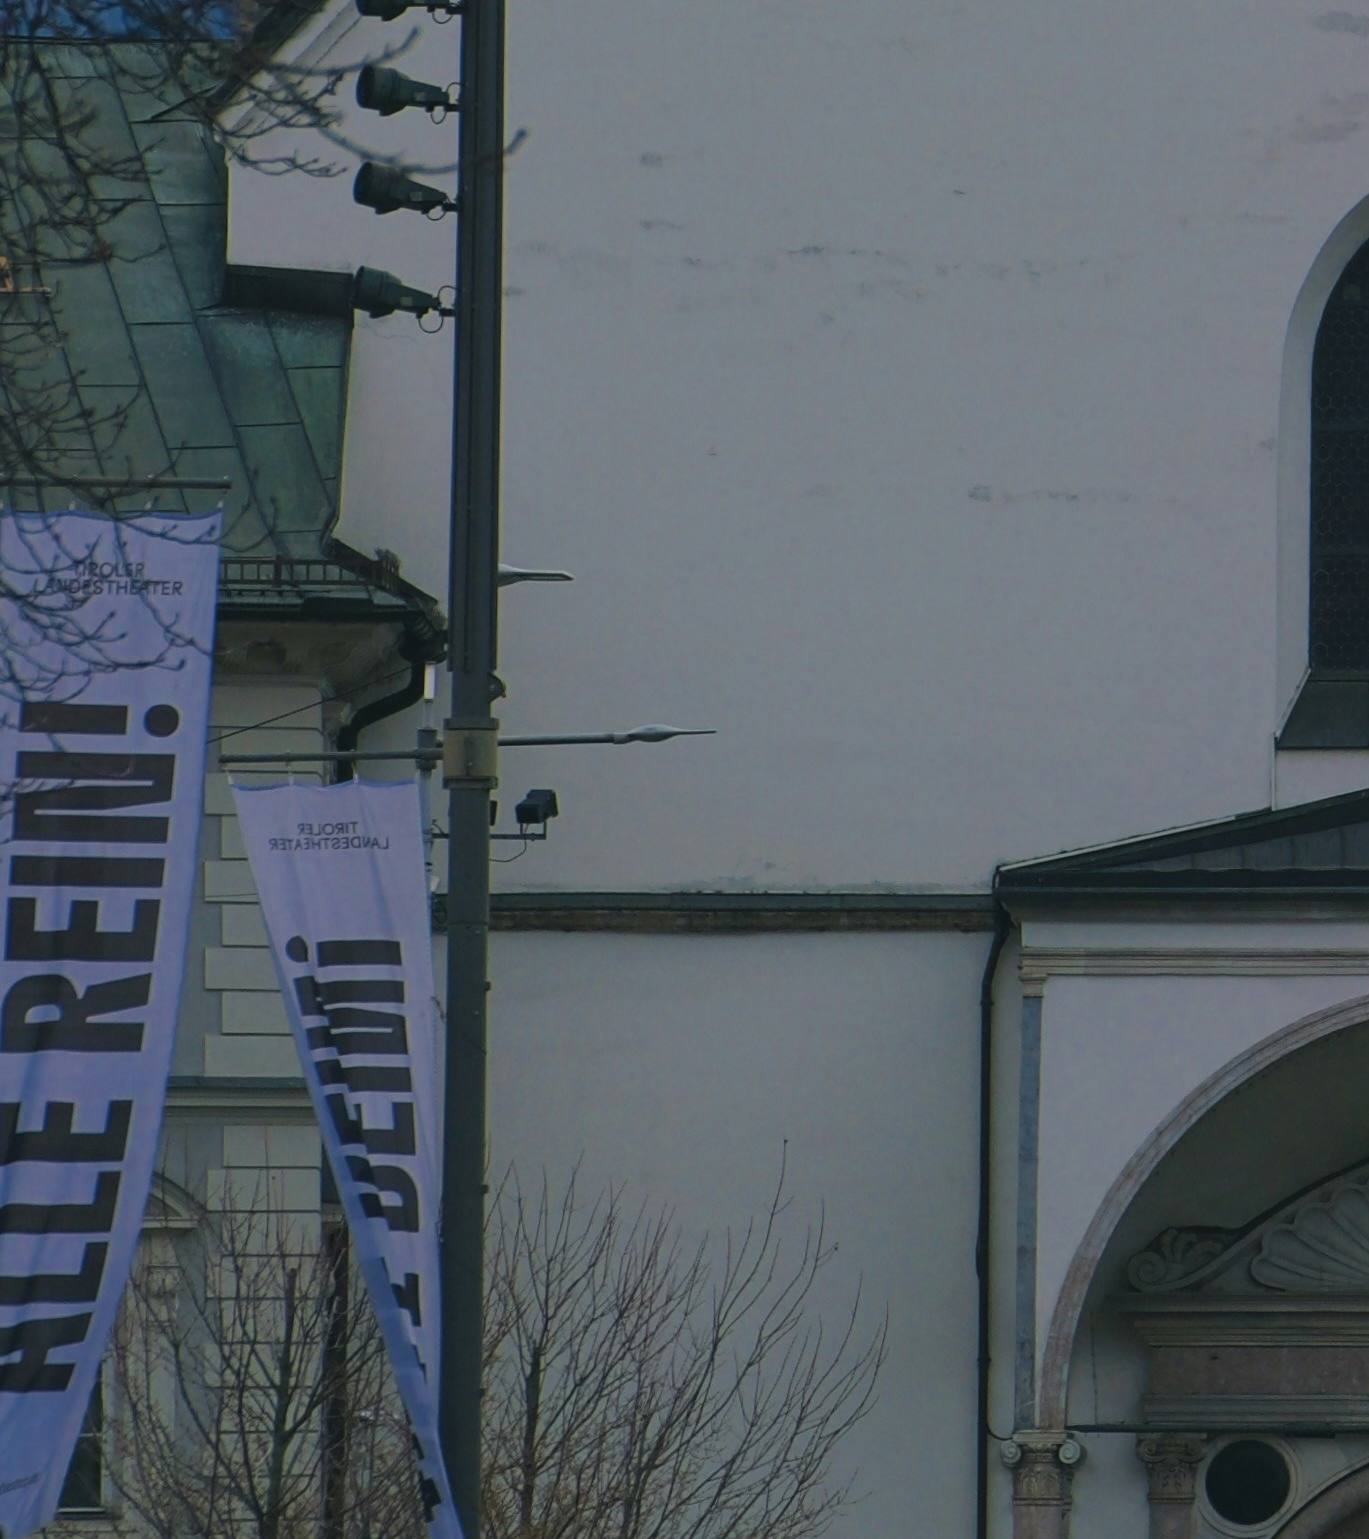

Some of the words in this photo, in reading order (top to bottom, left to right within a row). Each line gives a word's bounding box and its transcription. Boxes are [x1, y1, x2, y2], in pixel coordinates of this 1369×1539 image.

[75, 562, 146, 578] TIROLER
[34, 579, 184, 596] LANDESTHEATER
[4, 704, 180, 1054] REIN!
